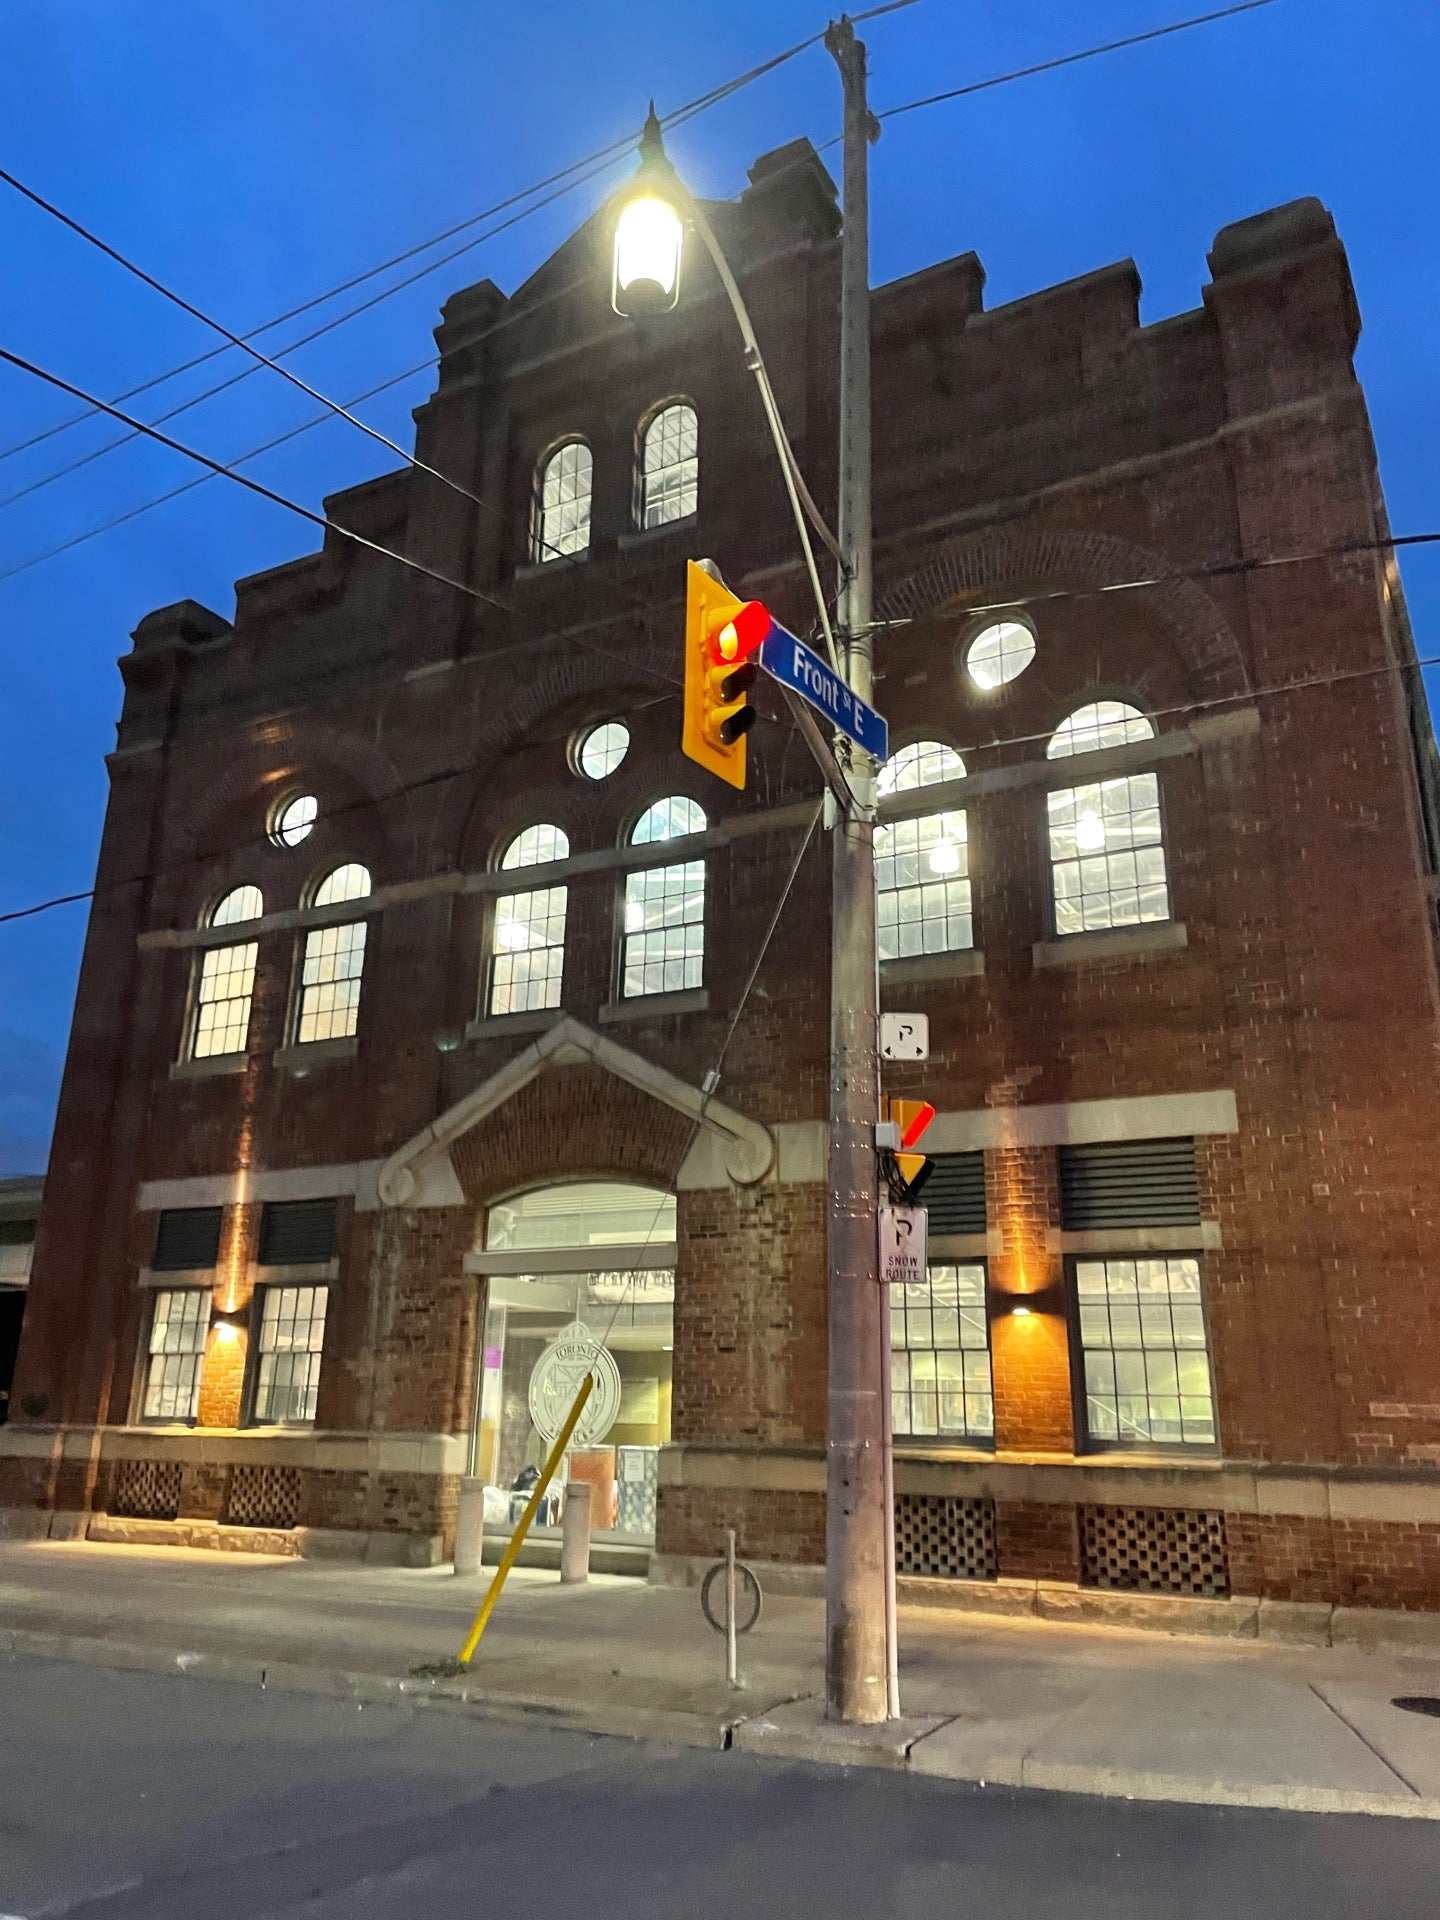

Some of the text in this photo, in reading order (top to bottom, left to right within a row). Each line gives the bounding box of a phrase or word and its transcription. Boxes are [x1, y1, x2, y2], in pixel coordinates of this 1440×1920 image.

[793, 644, 864, 736] Front St E
[888, 1255, 918, 1268] SNOW
[885, 1268, 920, 1281] ROUTE
[555, 1343, 599, 1361] TORONTO
